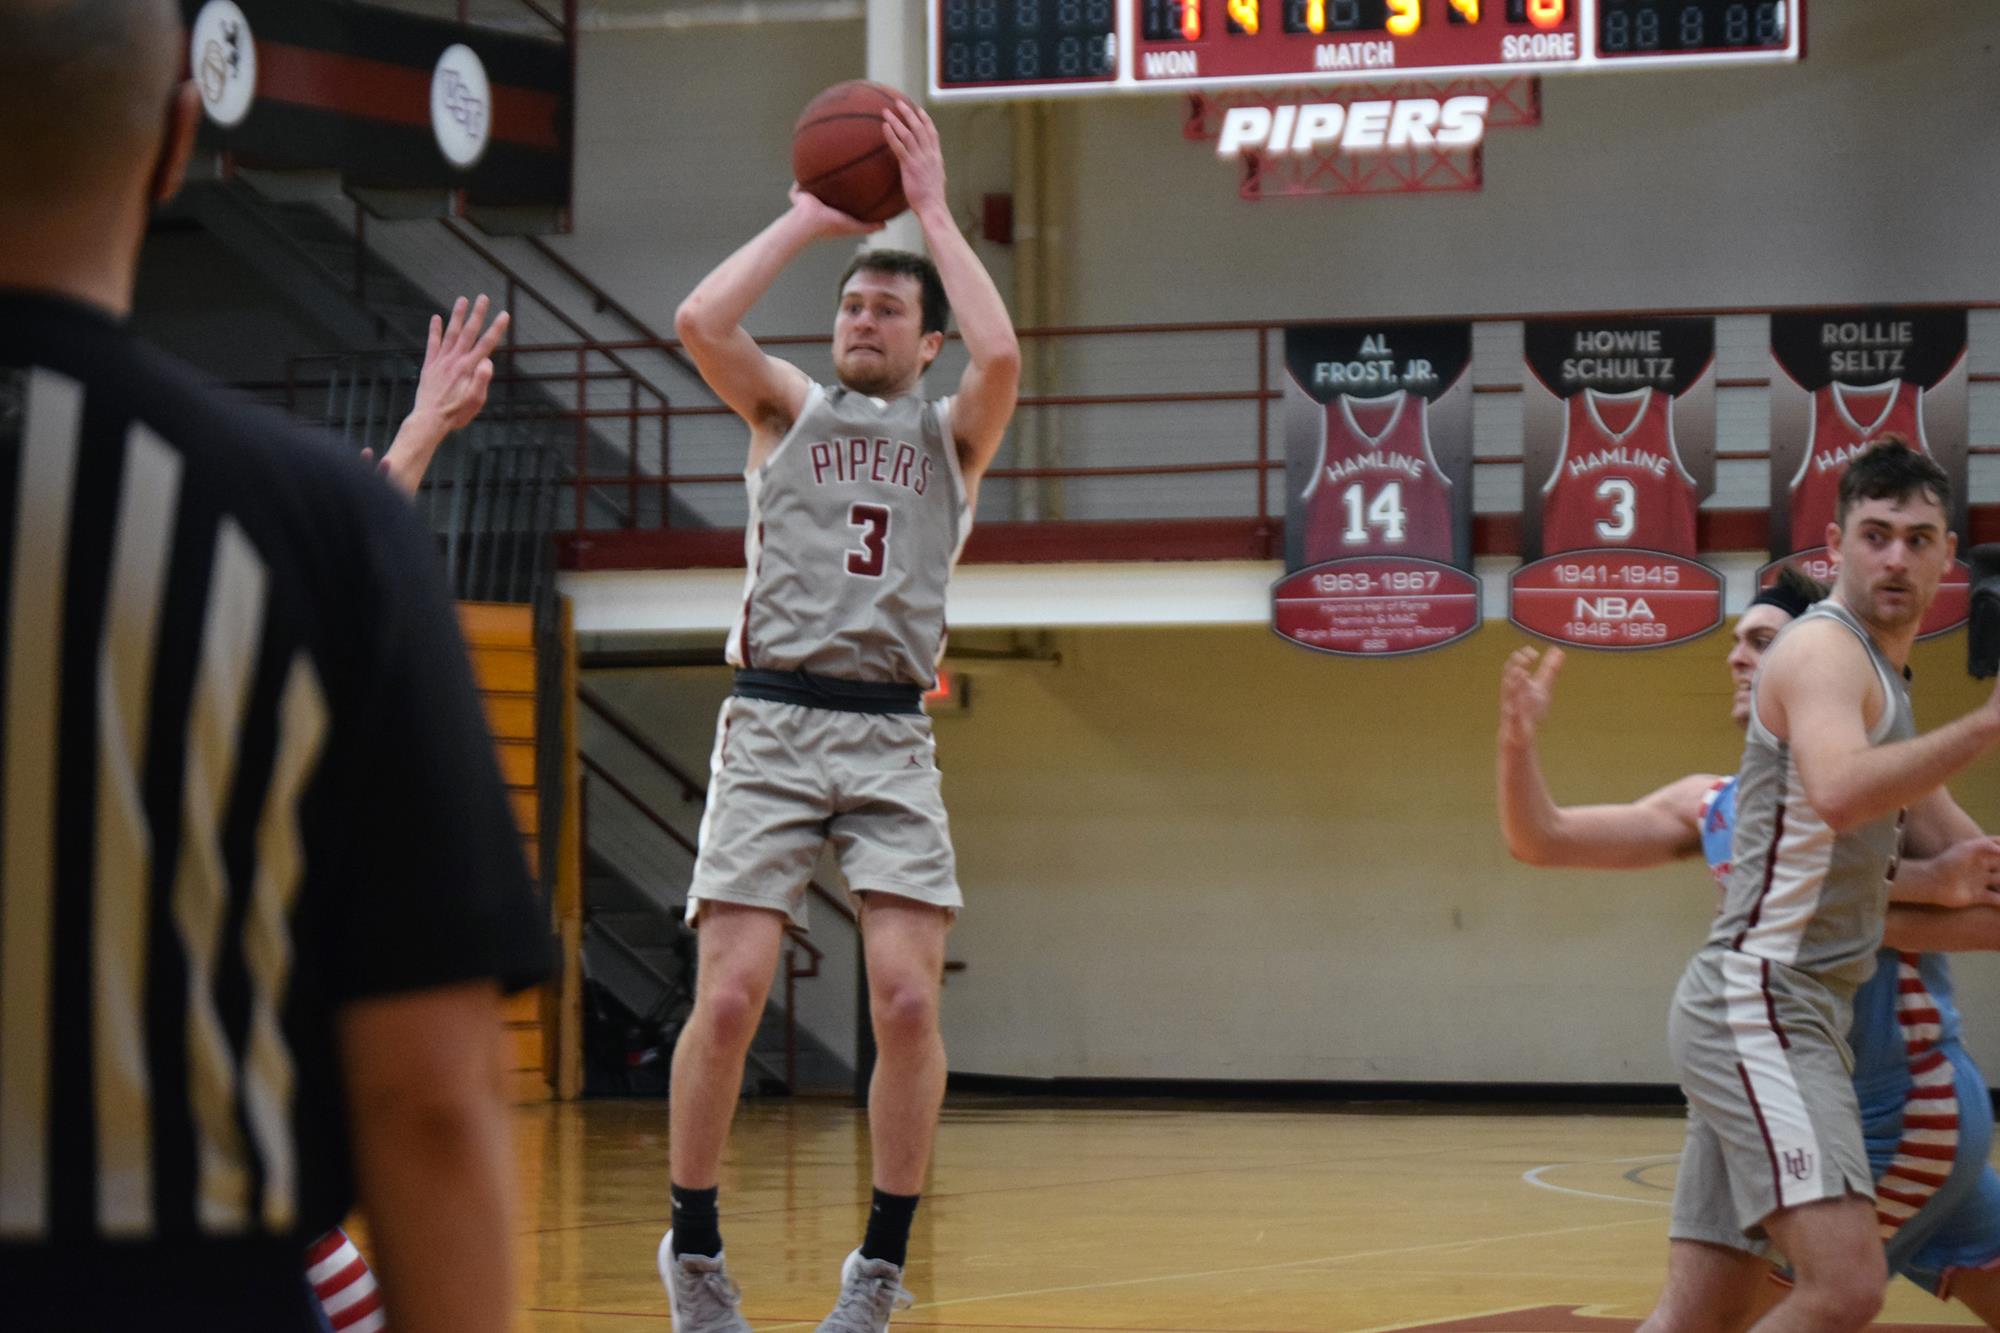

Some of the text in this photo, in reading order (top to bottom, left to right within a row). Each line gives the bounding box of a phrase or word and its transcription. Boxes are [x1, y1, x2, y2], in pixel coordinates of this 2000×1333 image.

[1315, 41, 1394, 69] MATCH
[1503, 32, 1575, 59] SCORE
[1145, 50, 1198, 76] WON
[1217, 95, 1489, 155] PIPERS
[1360, 334, 1392, 354] AL
[1576, 331, 1661, 352] HOWIE
[1822, 321, 1912, 344] ROLLIE
[1315, 359, 1438, 383] FROST, JR.
[1563, 358, 1674, 380] SCHULTZ
[1830, 350, 1905, 372] SELTZ
[809, 437, 934, 497] PIPERS
[1326, 451, 1426, 482] HAMLINE
[1569, 447, 1671, 477] HAMLINE
[1342, 481, 1406, 544] 14
[1596, 478, 1637, 540] 3
[843, 501, 892, 580] 3
[1312, 571, 1441, 592] 1963-1967
[1553, 565, 1680, 585] 1941-1945
[1575, 598, 1655, 619] NBA
